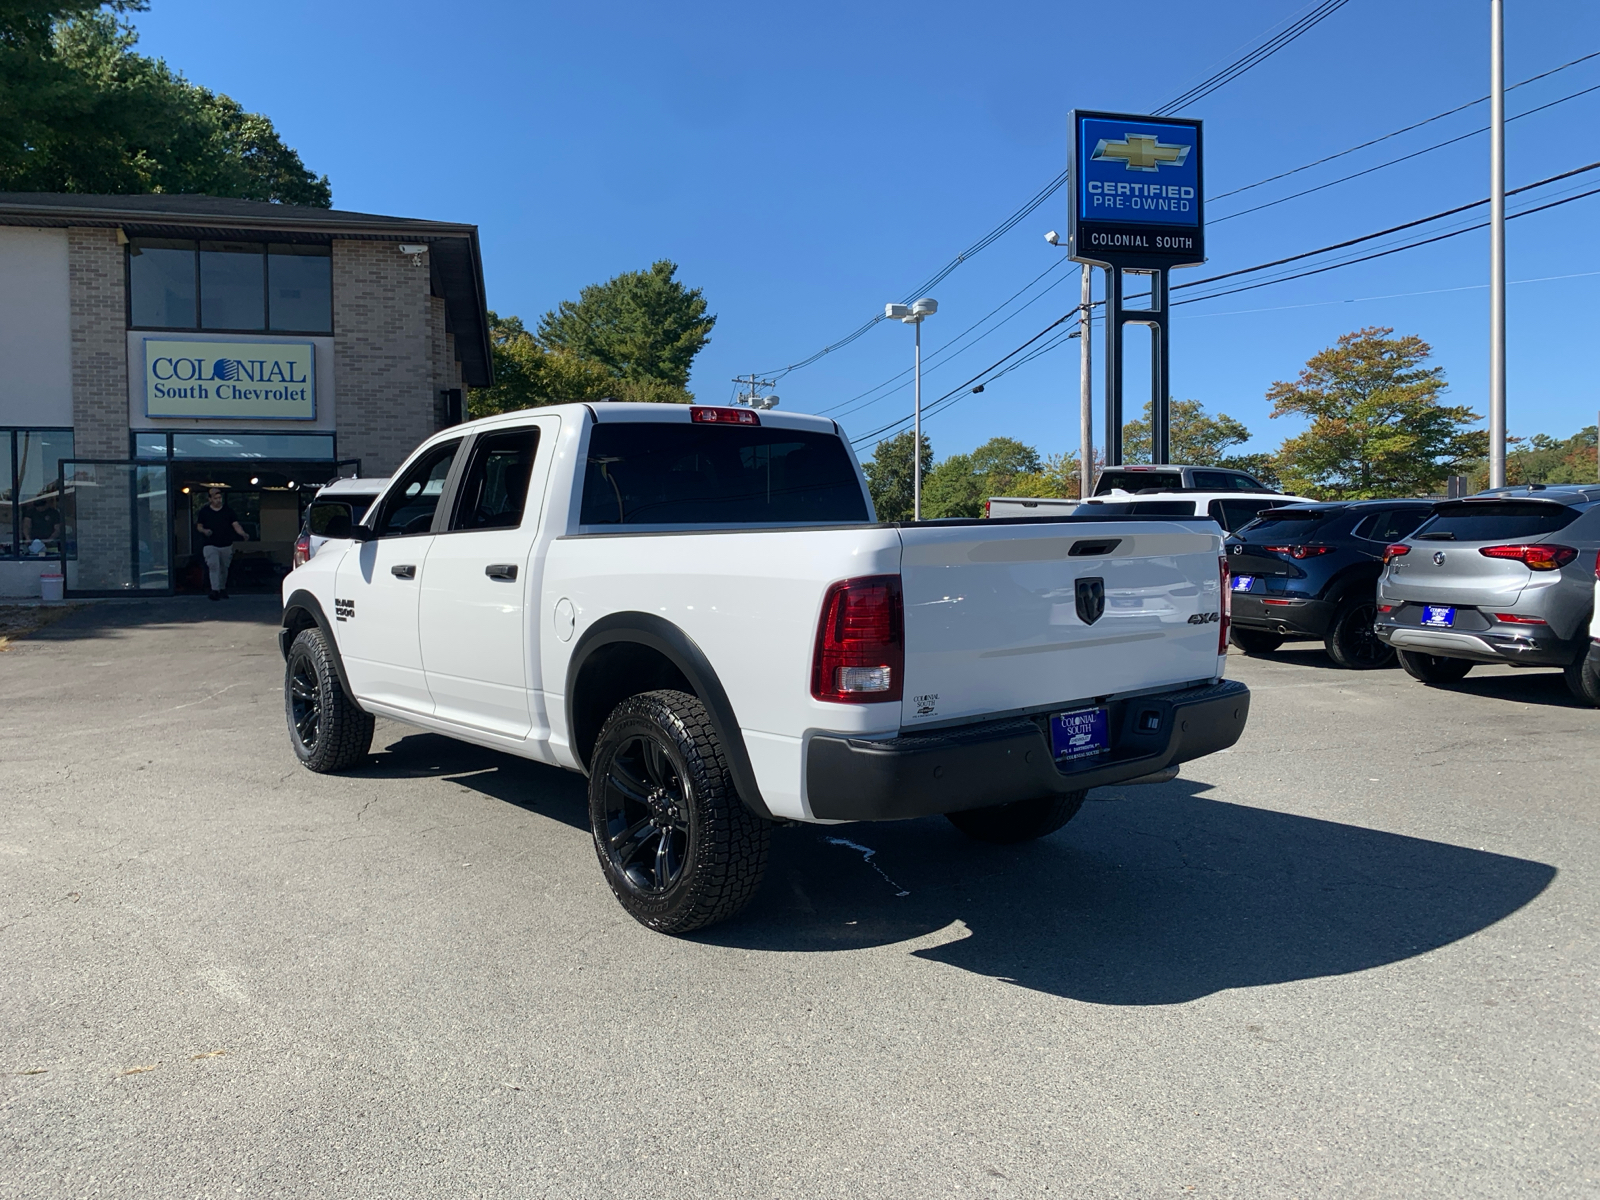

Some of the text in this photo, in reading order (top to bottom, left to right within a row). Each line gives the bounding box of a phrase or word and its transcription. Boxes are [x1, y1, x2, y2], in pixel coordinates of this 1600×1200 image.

[1088, 181, 1194, 198] CERTIFIED
[1094, 196, 1190, 212] PRE-OWNED
[1092, 233, 1192, 248] COLONIAL SOUTH
[152, 358, 306, 383] COLONIAL
[154, 383, 306, 400] South Chevrolet
[335, 598, 354, 608] RAM
[913, 694, 940, 702] COLONIAL
[1062, 714, 1096, 728] COLONIAL
[1067, 724, 1092, 736] SOUTH
